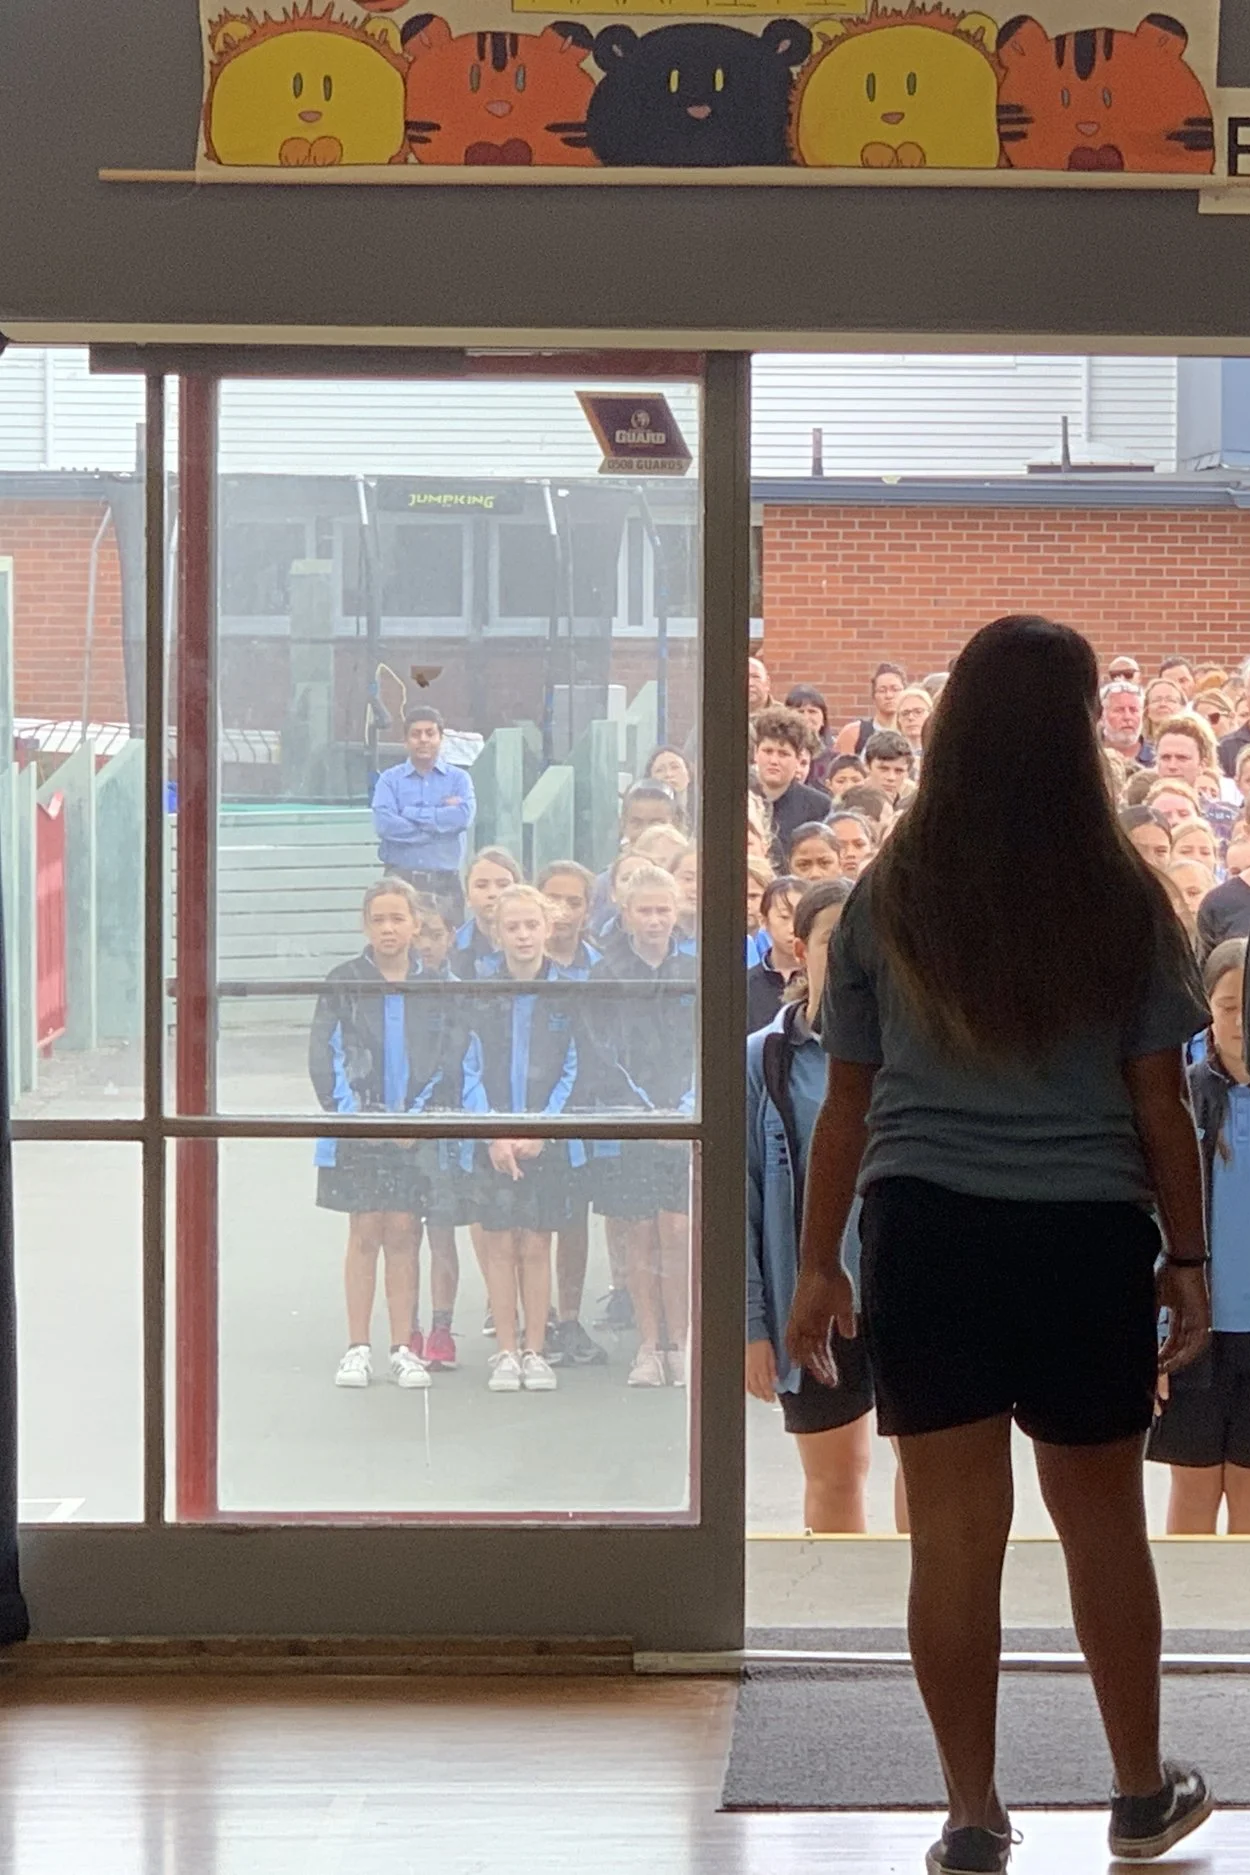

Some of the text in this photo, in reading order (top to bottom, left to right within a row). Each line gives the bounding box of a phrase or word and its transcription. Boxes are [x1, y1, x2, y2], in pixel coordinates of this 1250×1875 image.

[614, 430, 666, 444] GUARD
[636, 459, 683, 470] GUARDS
[408, 493, 495, 509] JUMPKING
